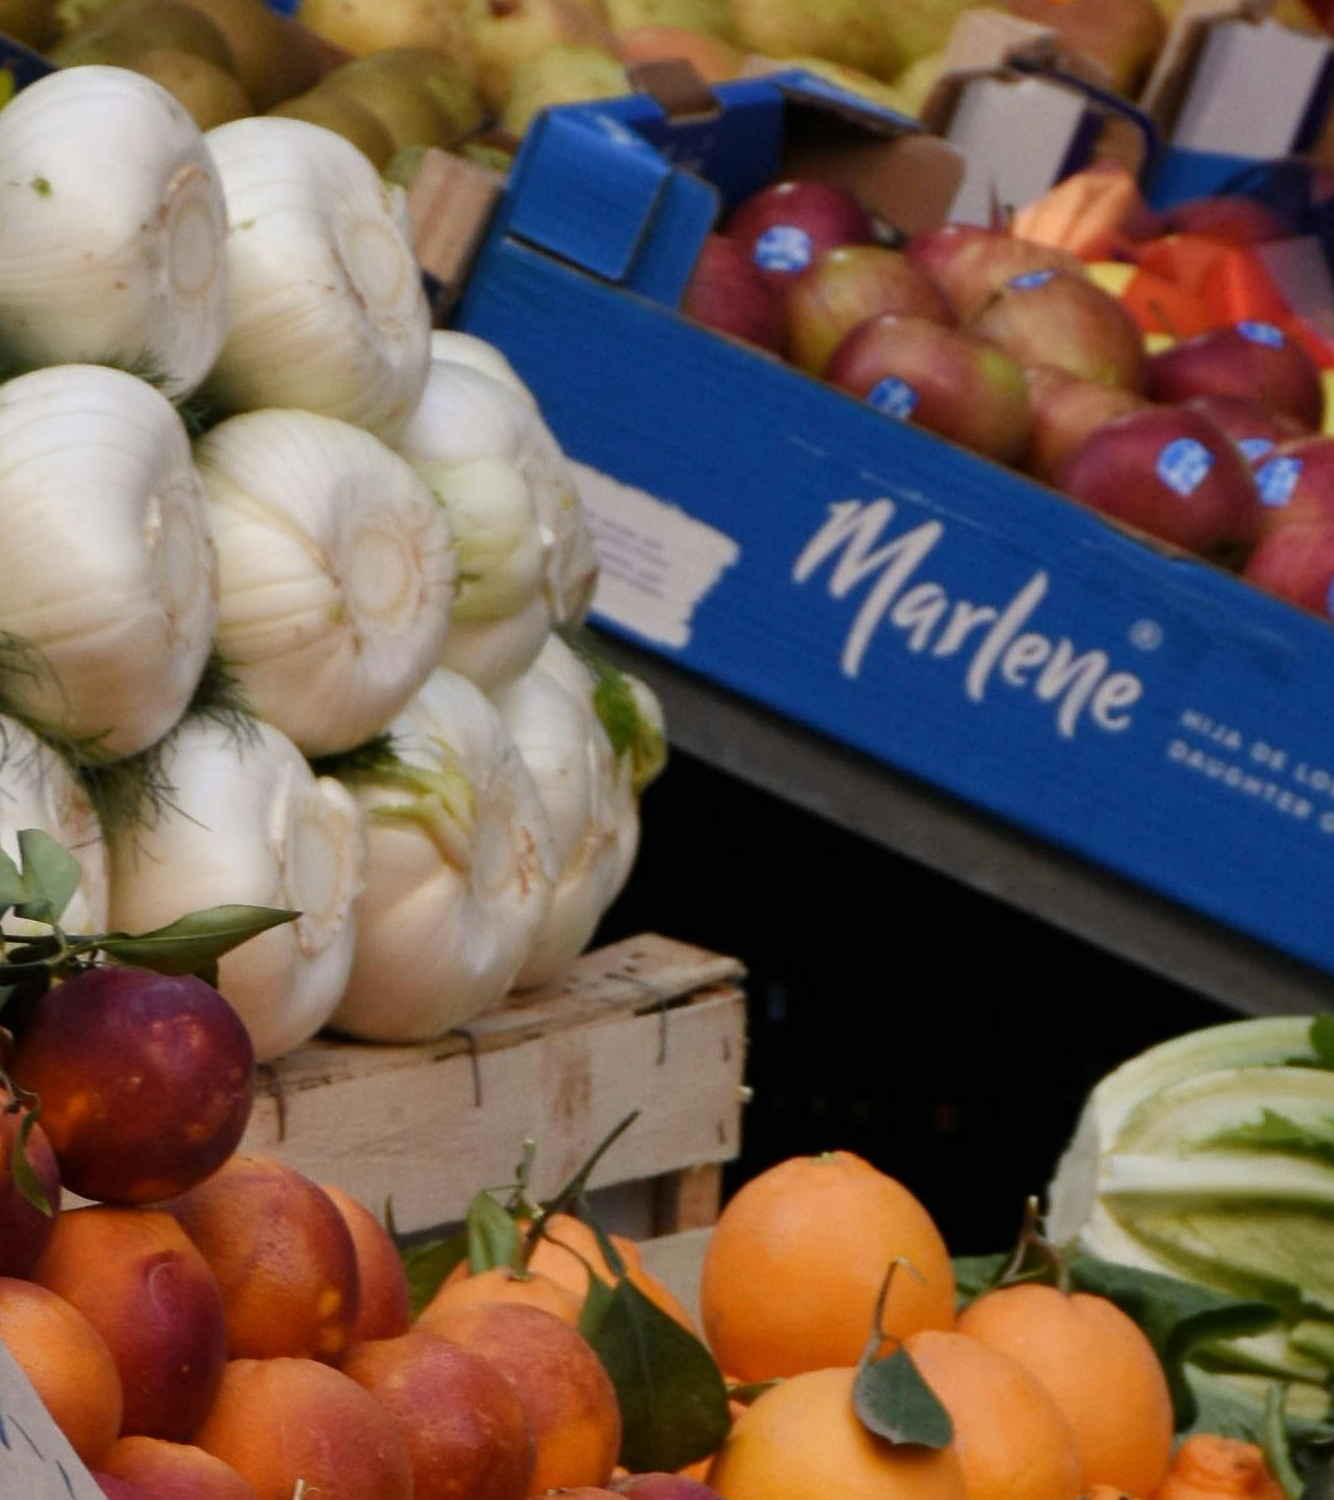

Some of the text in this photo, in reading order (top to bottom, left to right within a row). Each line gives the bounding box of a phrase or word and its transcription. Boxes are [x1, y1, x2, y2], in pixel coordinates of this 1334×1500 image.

[790, 498, 1145, 737] Marlene
[1168, 739, 1313, 821] DAUGHTER
[1250, 740, 1288, 773] DE
